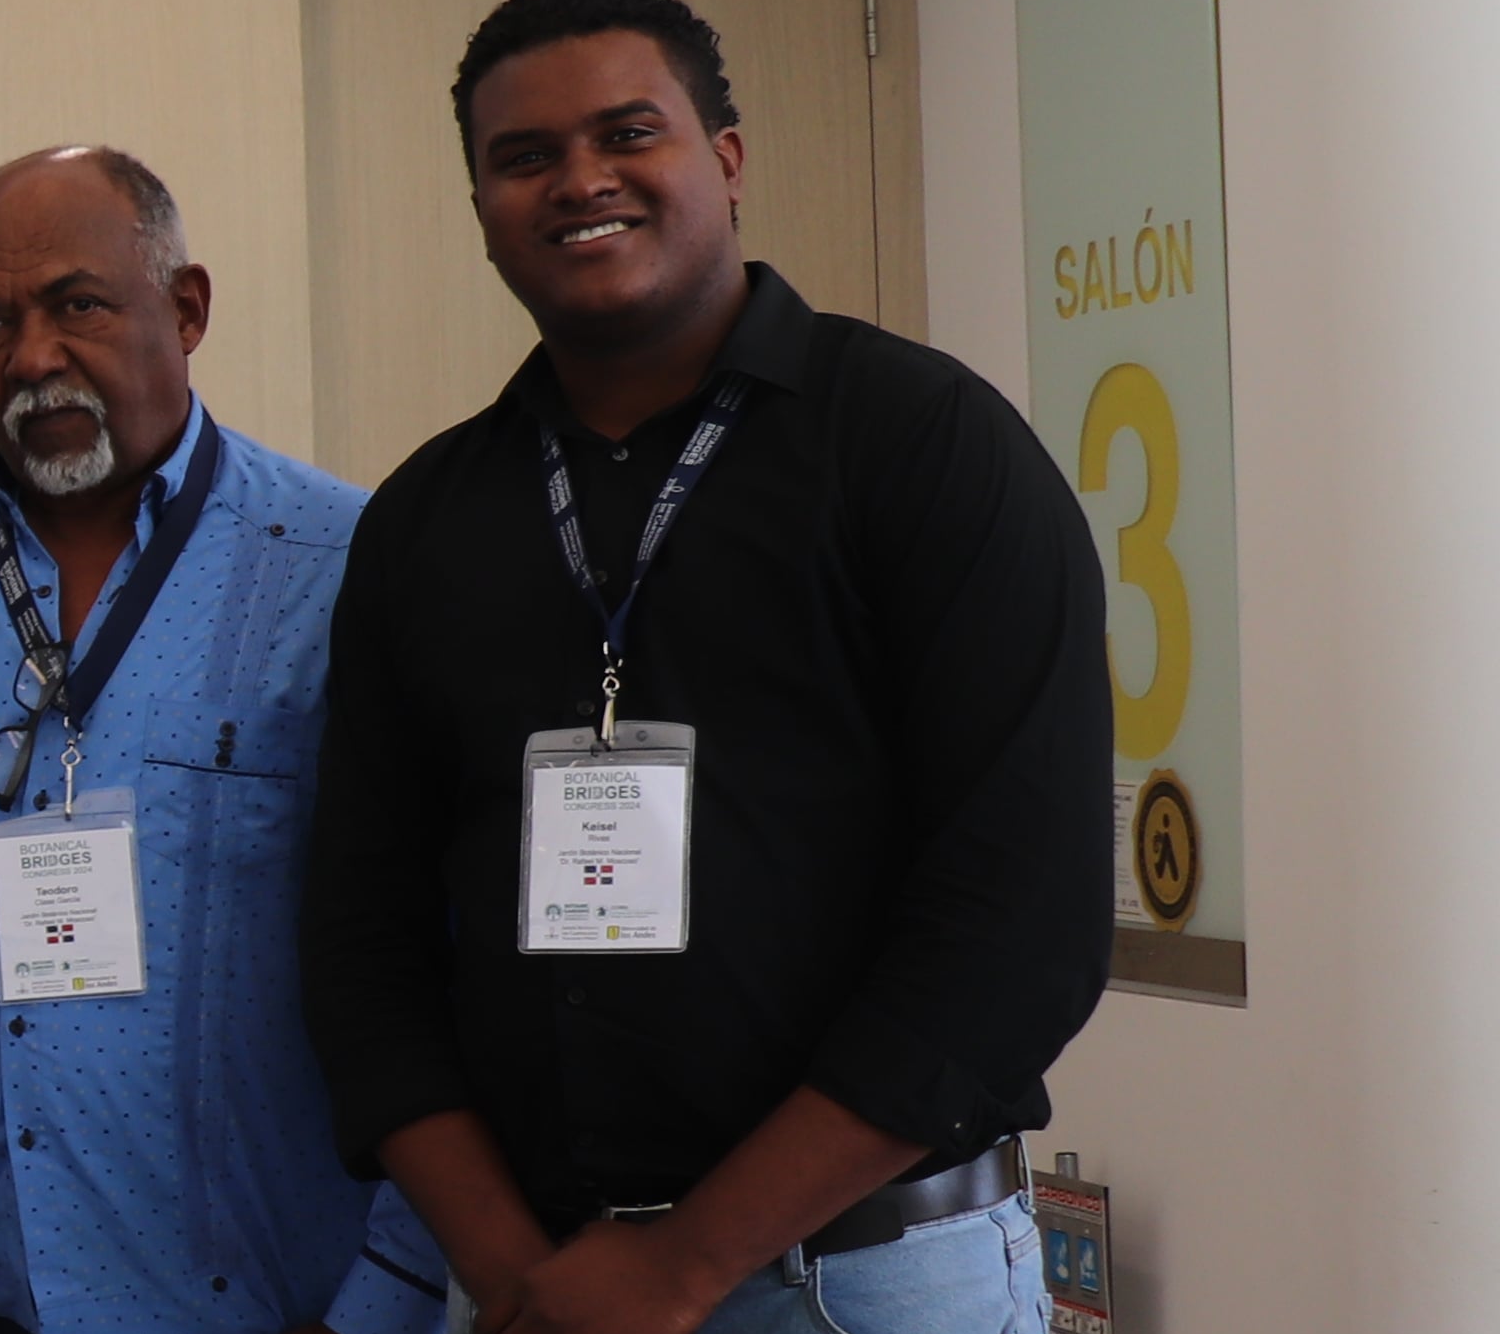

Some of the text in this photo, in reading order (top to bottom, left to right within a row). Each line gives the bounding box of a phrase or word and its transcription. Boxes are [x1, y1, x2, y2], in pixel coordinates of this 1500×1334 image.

[1053, 207, 1195, 321] SALÓN
[1078, 362, 1192, 761] 3
[564, 771, 641, 785] BOTANICAL
[564, 786, 641, 801] BRIDGES
[582, 821, 618, 832] Keisel
[20, 840, 91, 855] BOTANICAL
[21, 852, 92, 869] BRIDGES
[35, 885, 79, 897] Teodoro
